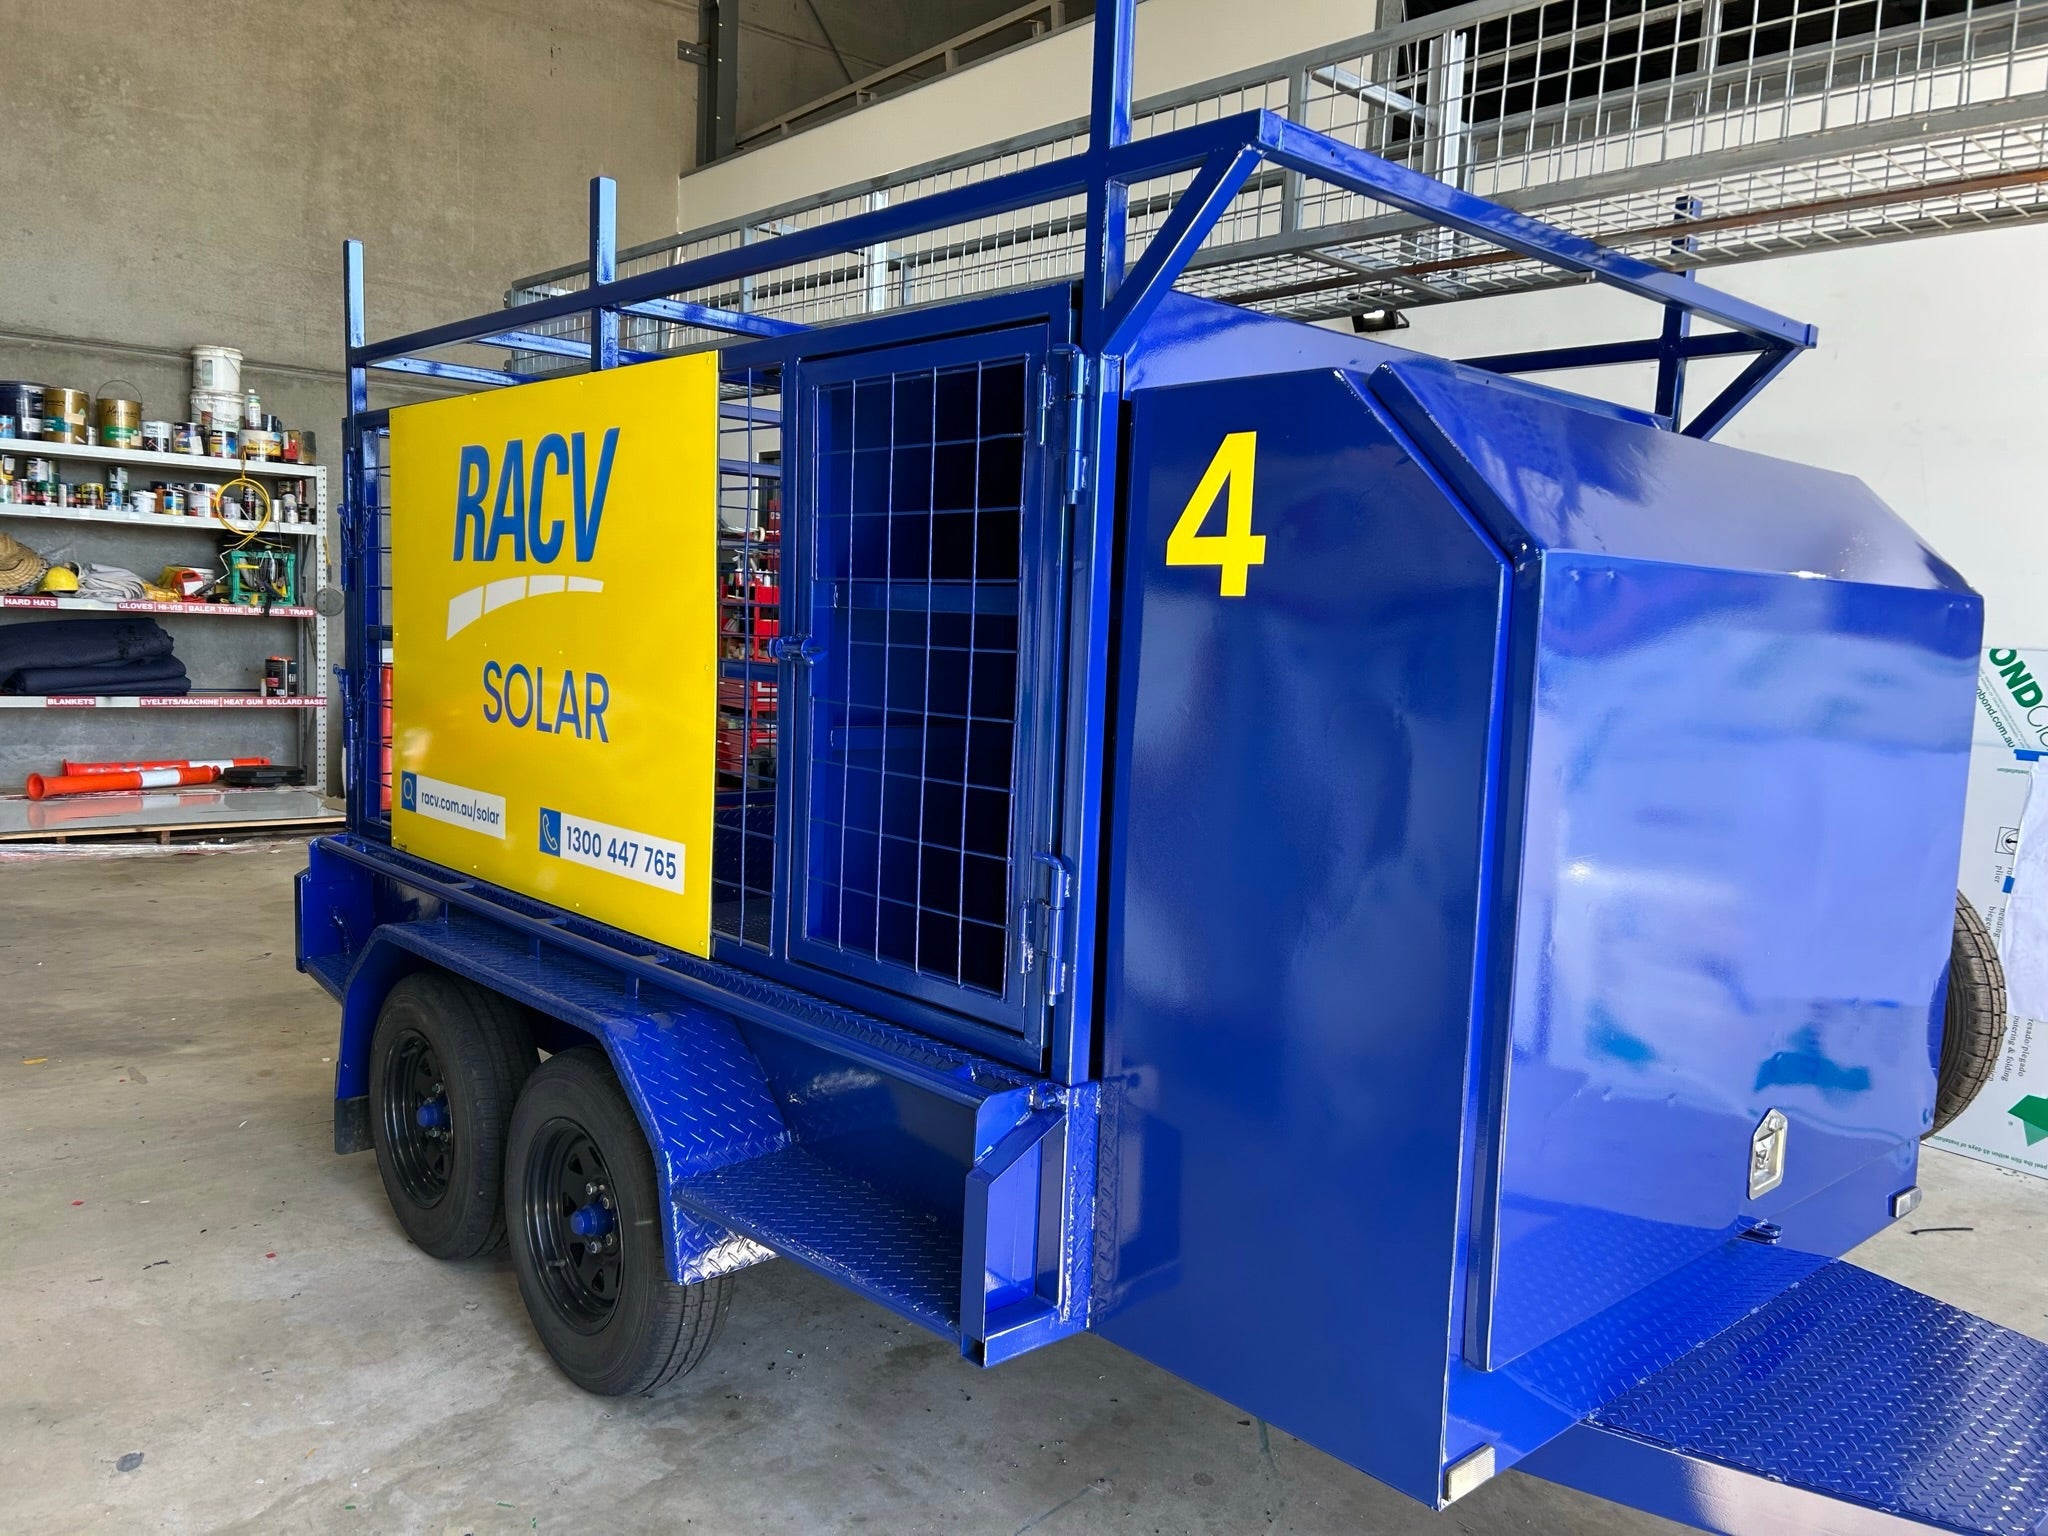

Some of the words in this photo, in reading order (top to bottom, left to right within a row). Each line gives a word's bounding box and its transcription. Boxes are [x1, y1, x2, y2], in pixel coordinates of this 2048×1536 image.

[453, 426, 621, 565] RACV
[1165, 431, 1266, 597] 4
[4, 598, 31, 606] HARD
[33, 599, 57, 607] HATS
[118, 602, 154, 610] GLOVES
[157, 604, 184, 612] HI-VIS
[188, 605, 216, 613] BALER
[217, 606, 243, 614] TWINE
[247, 607, 285, 615] BRUHES
[47, 698, 95, 706] BLANKETS
[140, 698, 219, 706] EYELETS/MACHINE
[223, 698, 245, 706] HEAT
[246, 698, 264, 706] GUN
[266, 698, 303, 706] BOLLARD
[483, 660, 609, 743] SOLAR
[421, 791, 500, 825] racv.com.au/solar
[566, 825, 602, 858] 1300
[607, 838, 639, 868] 447
[644, 846, 677, 880] 765
